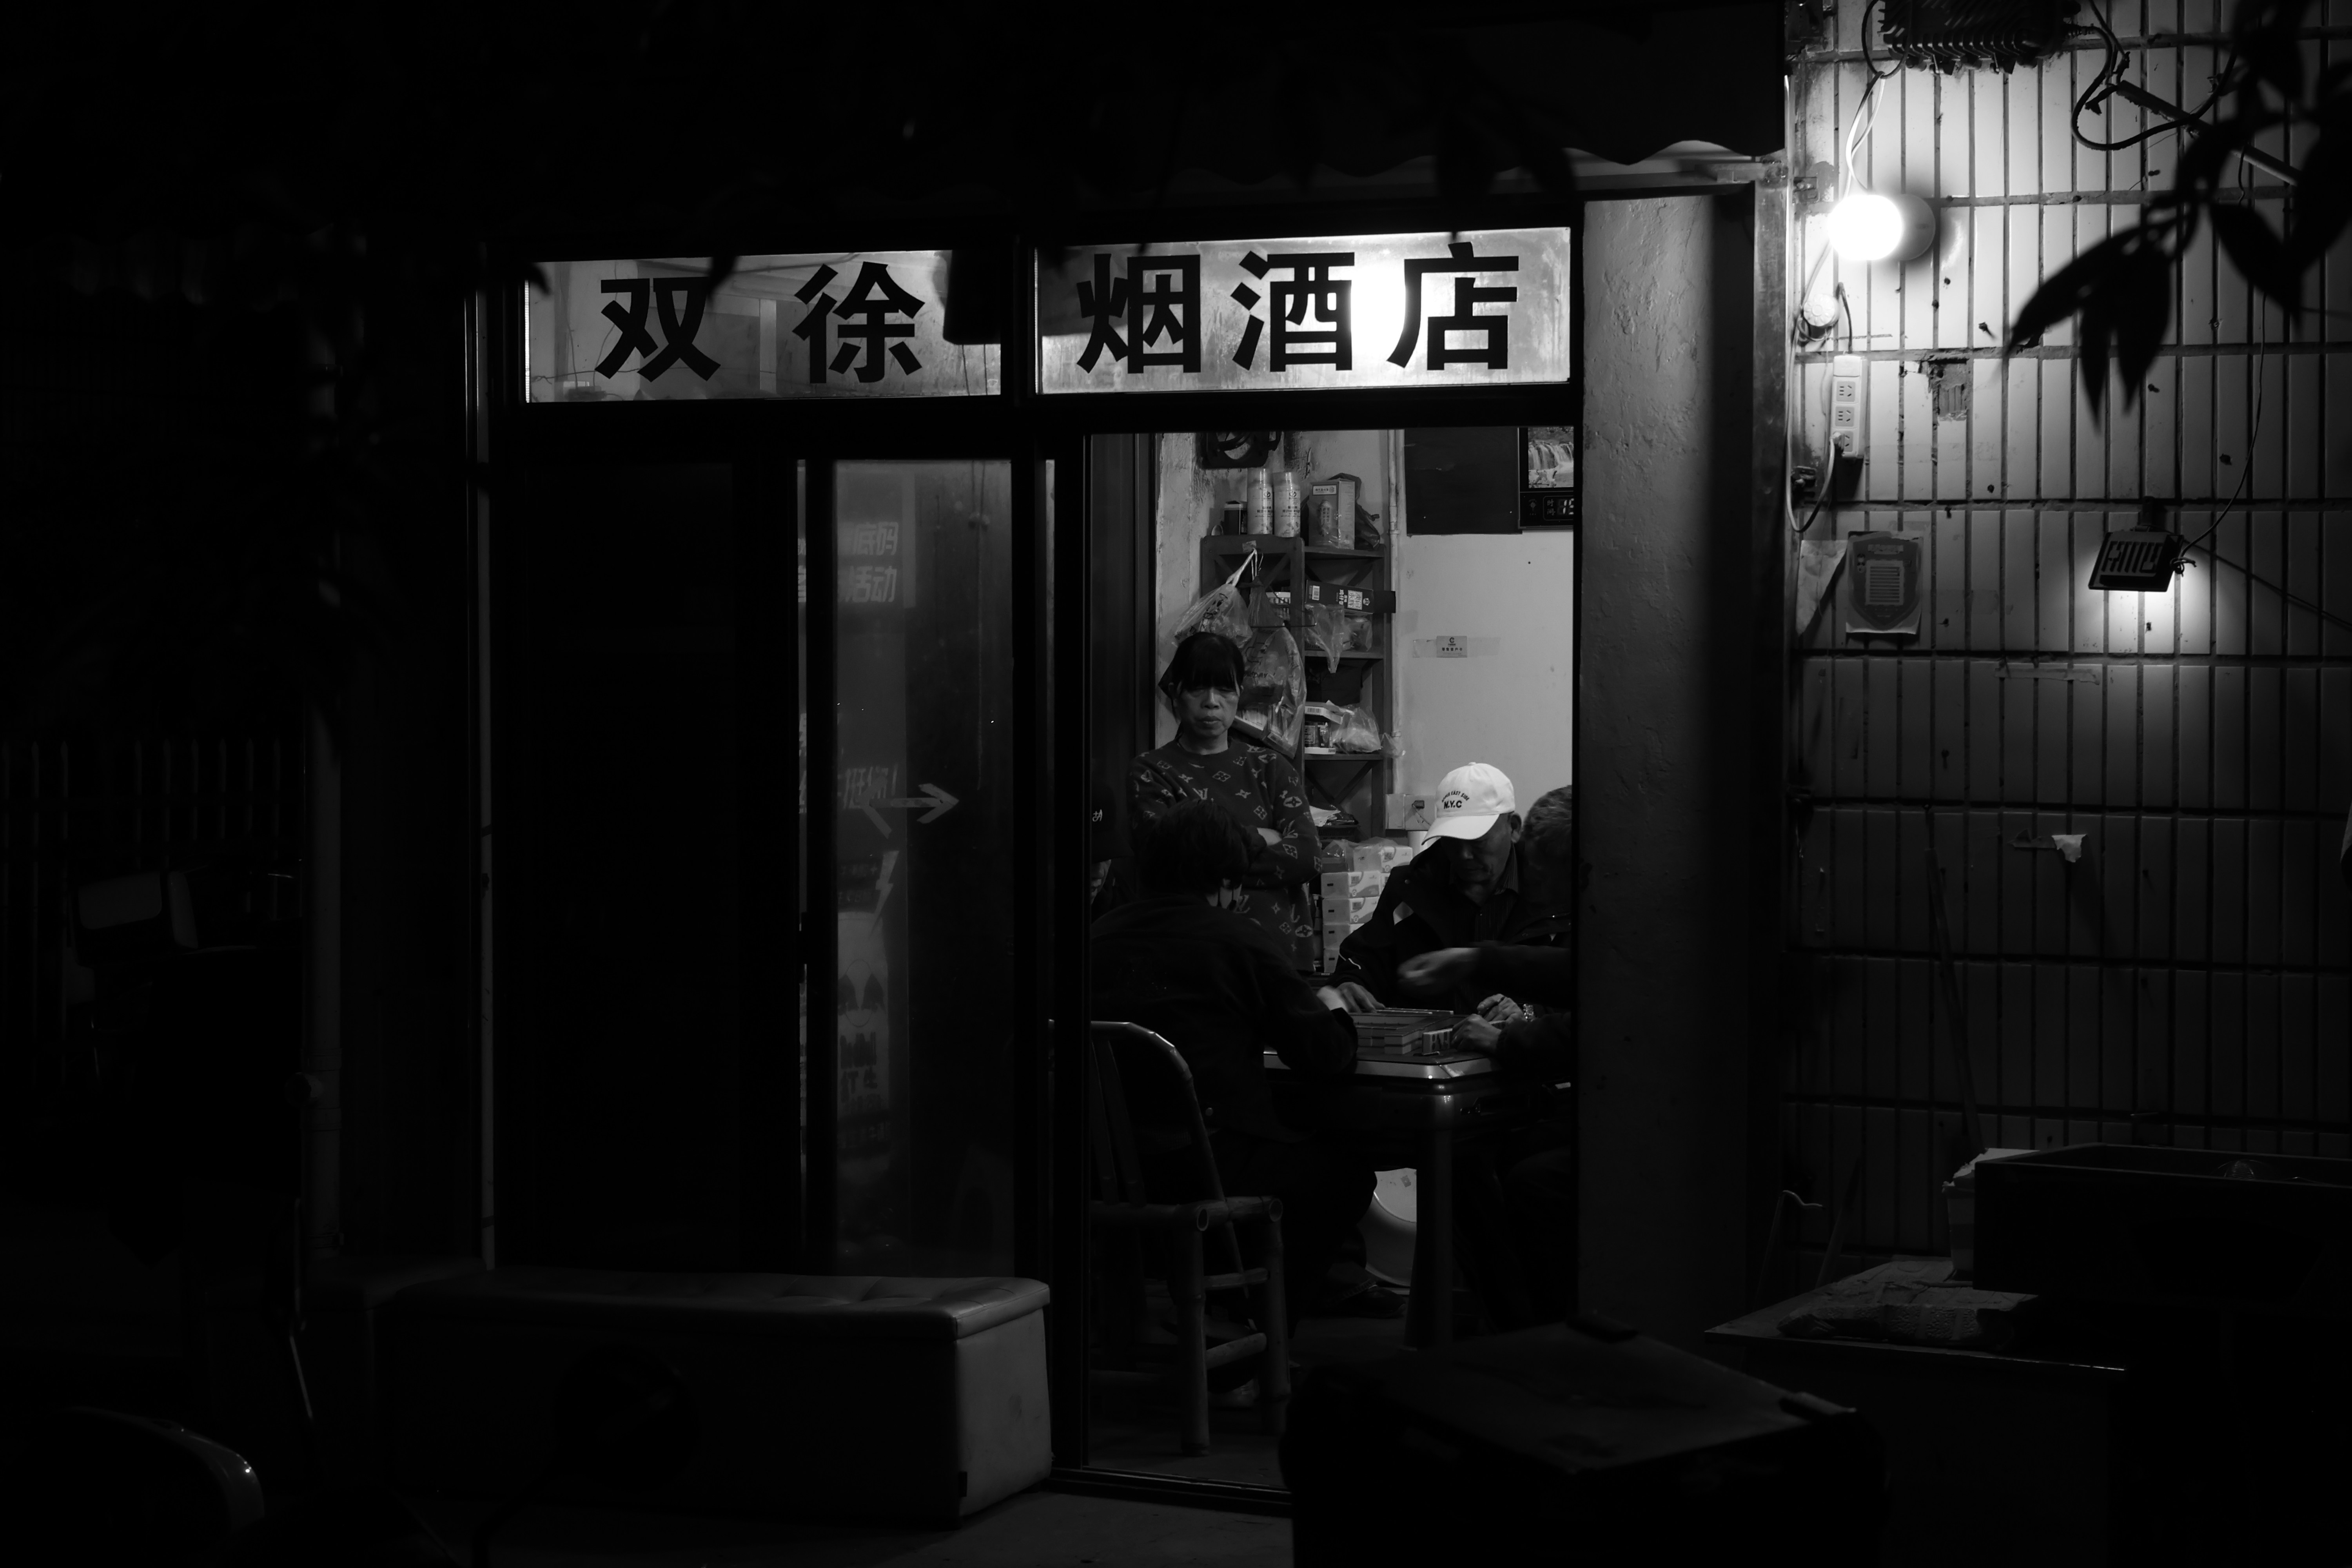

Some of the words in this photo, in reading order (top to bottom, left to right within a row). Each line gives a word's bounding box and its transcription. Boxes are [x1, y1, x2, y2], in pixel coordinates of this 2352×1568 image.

[595, 261, 925, 384] 双徐
[1076, 242, 1519, 374] 烟酒店
[1547, 499, 1554, 515] 时间
[845, 565, 898, 603] 活动
[1444, 800, 1462, 809] N.Y.C
